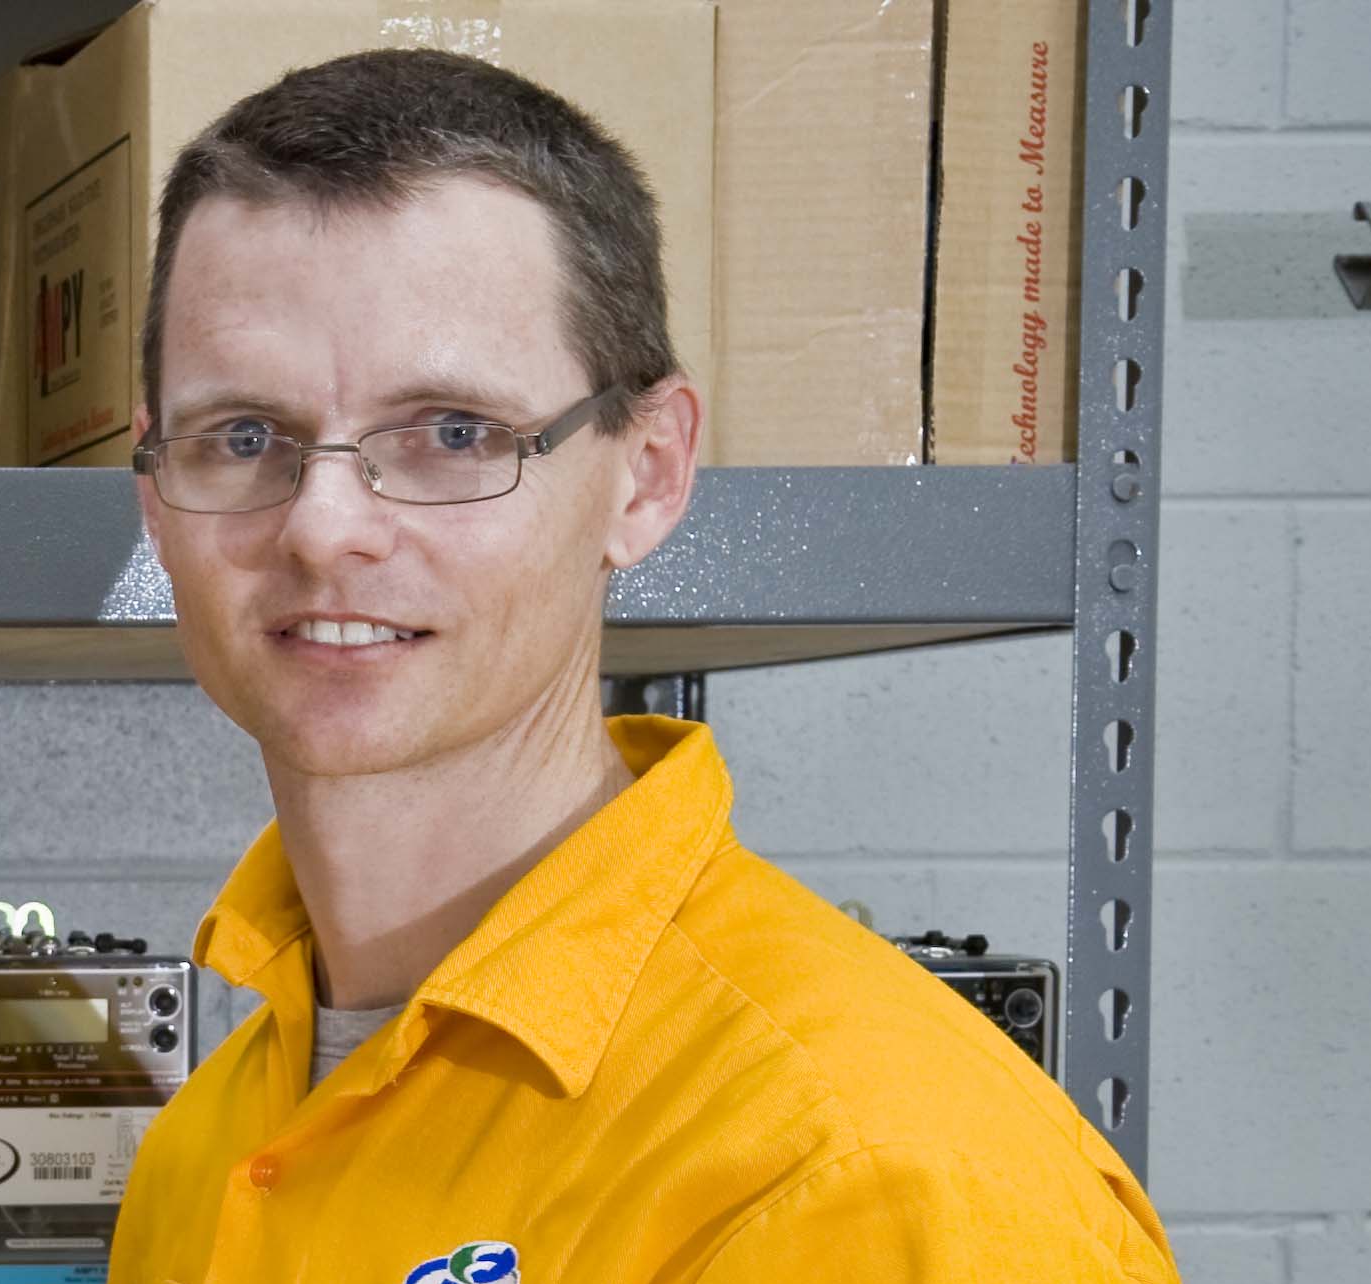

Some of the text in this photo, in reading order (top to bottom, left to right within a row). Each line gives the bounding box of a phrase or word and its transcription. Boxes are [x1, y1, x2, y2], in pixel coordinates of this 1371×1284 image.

[1019, 40, 1048, 175] Measure
[1032, 184, 1041, 214] to
[1017, 222, 1041, 302] made
[30, 1153, 96, 1166] 30803103
